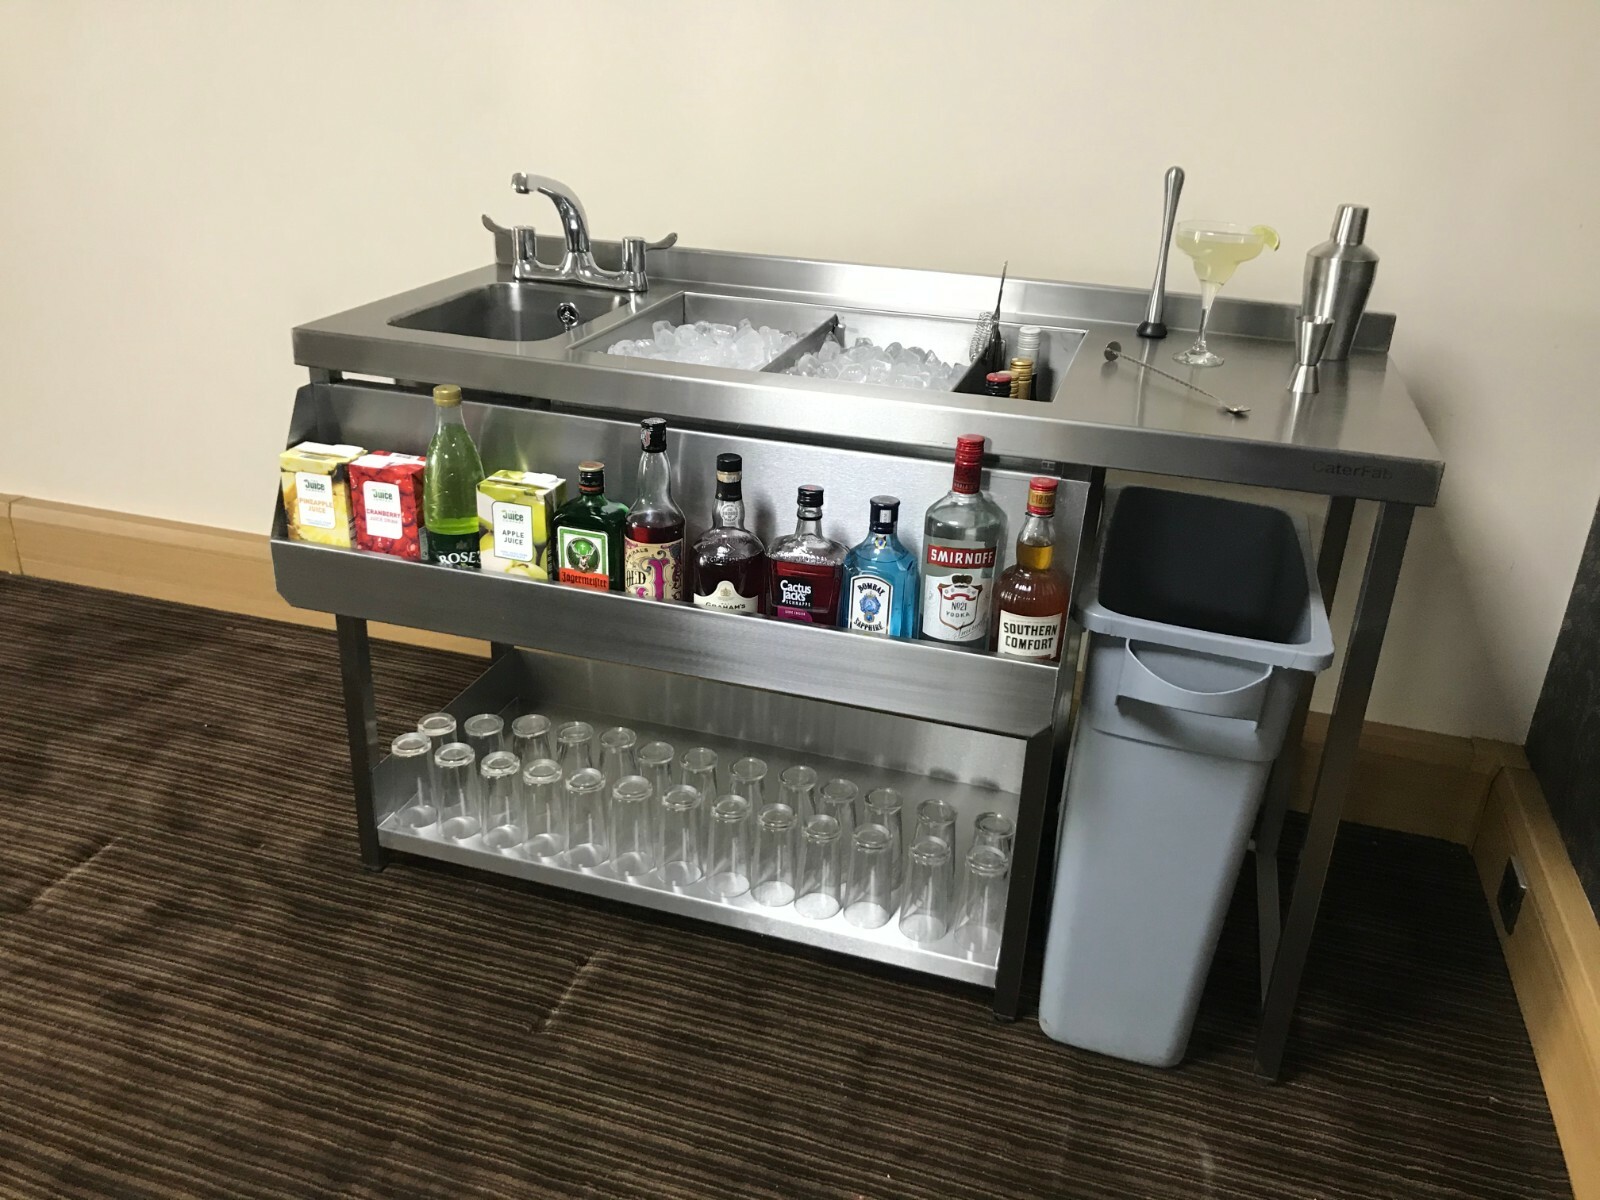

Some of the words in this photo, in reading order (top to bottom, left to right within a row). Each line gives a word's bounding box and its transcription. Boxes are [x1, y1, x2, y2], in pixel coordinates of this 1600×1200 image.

[1312, 461, 1393, 480] CaterFab
[366, 508, 401, 519] CRANBERRY
[502, 529, 525, 539] APPLE
[504, 537, 524, 546] JUICE
[931, 548, 994, 565] SMIRNOFF
[780, 579, 812, 594] Cactus
[857, 582, 886, 596] BOMBAY
[853, 617, 884, 631] SAPPHIRE
[1003, 622, 1058, 636] SOUTHERN
[1005, 635, 1054, 650] COMFORT
